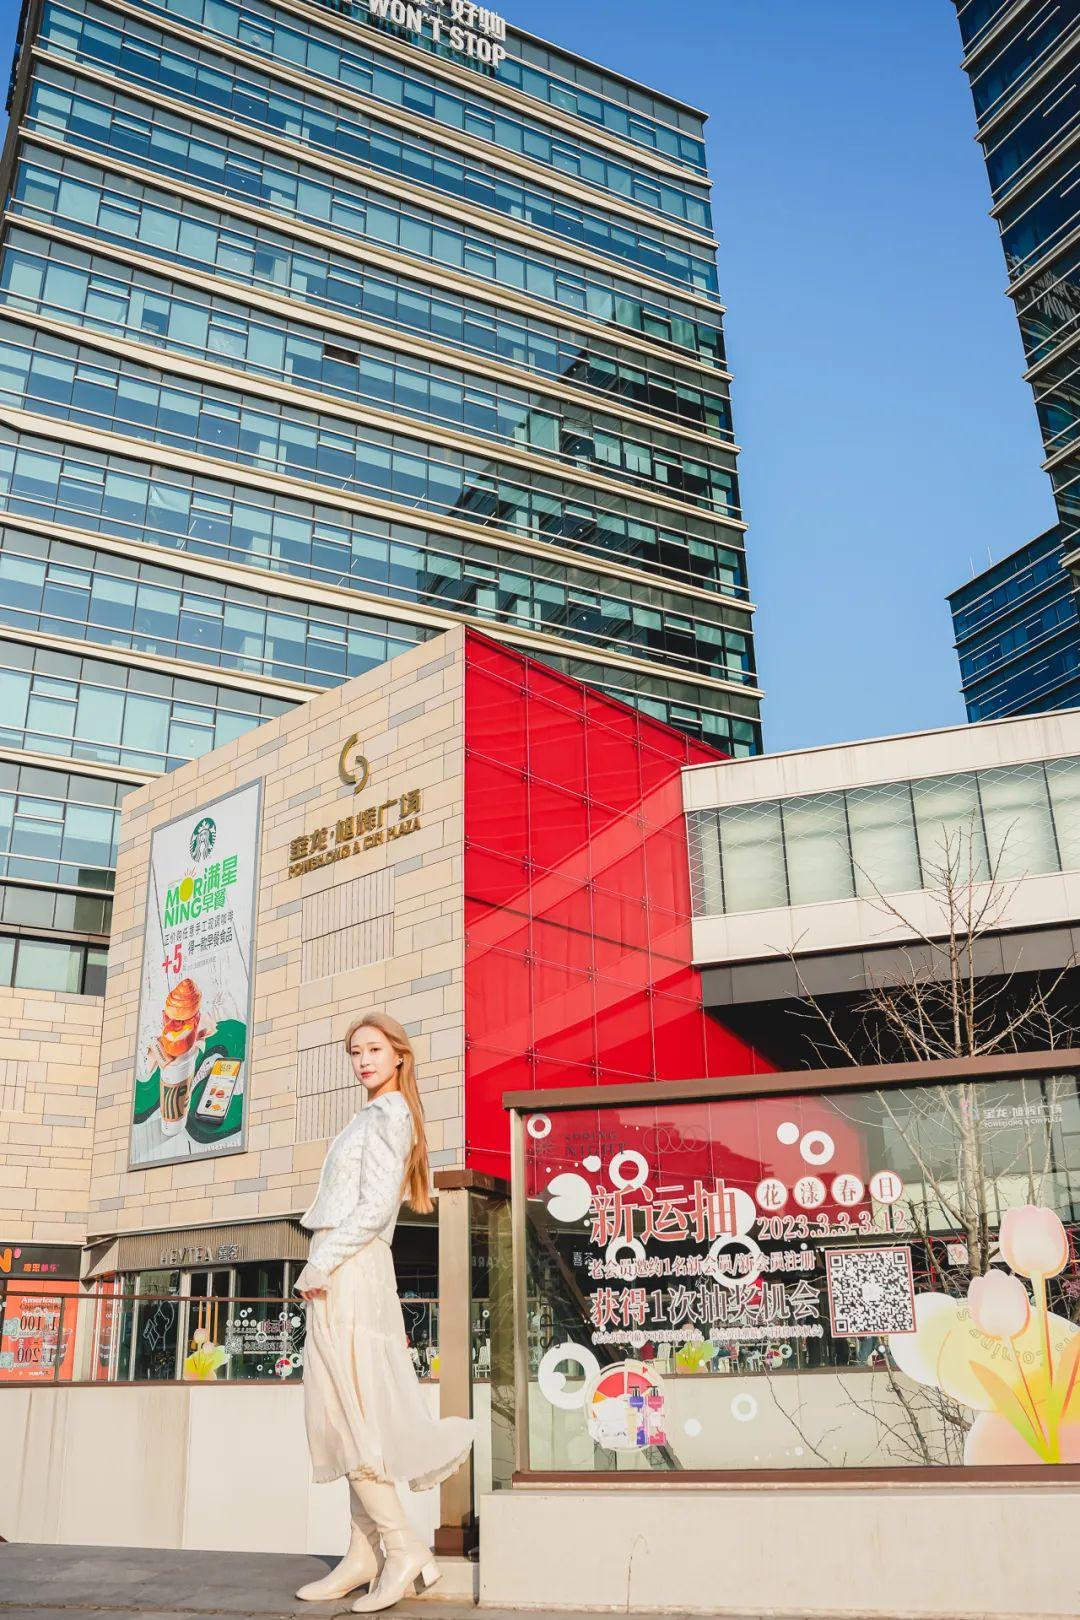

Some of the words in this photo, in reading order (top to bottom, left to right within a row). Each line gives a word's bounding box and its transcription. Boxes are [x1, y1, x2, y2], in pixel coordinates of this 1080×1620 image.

[370, 0, 444, 43] WON'T
[449, 26, 507, 69] STOP
[203, 855, 238, 893] 满星
[163, 898, 202, 929] NING
[589, 1178, 739, 1247] 新运抽
[762, 1176, 894, 1207] 花漾春日
[590, 1279, 820, 1328] 获得1次抽奖机会
